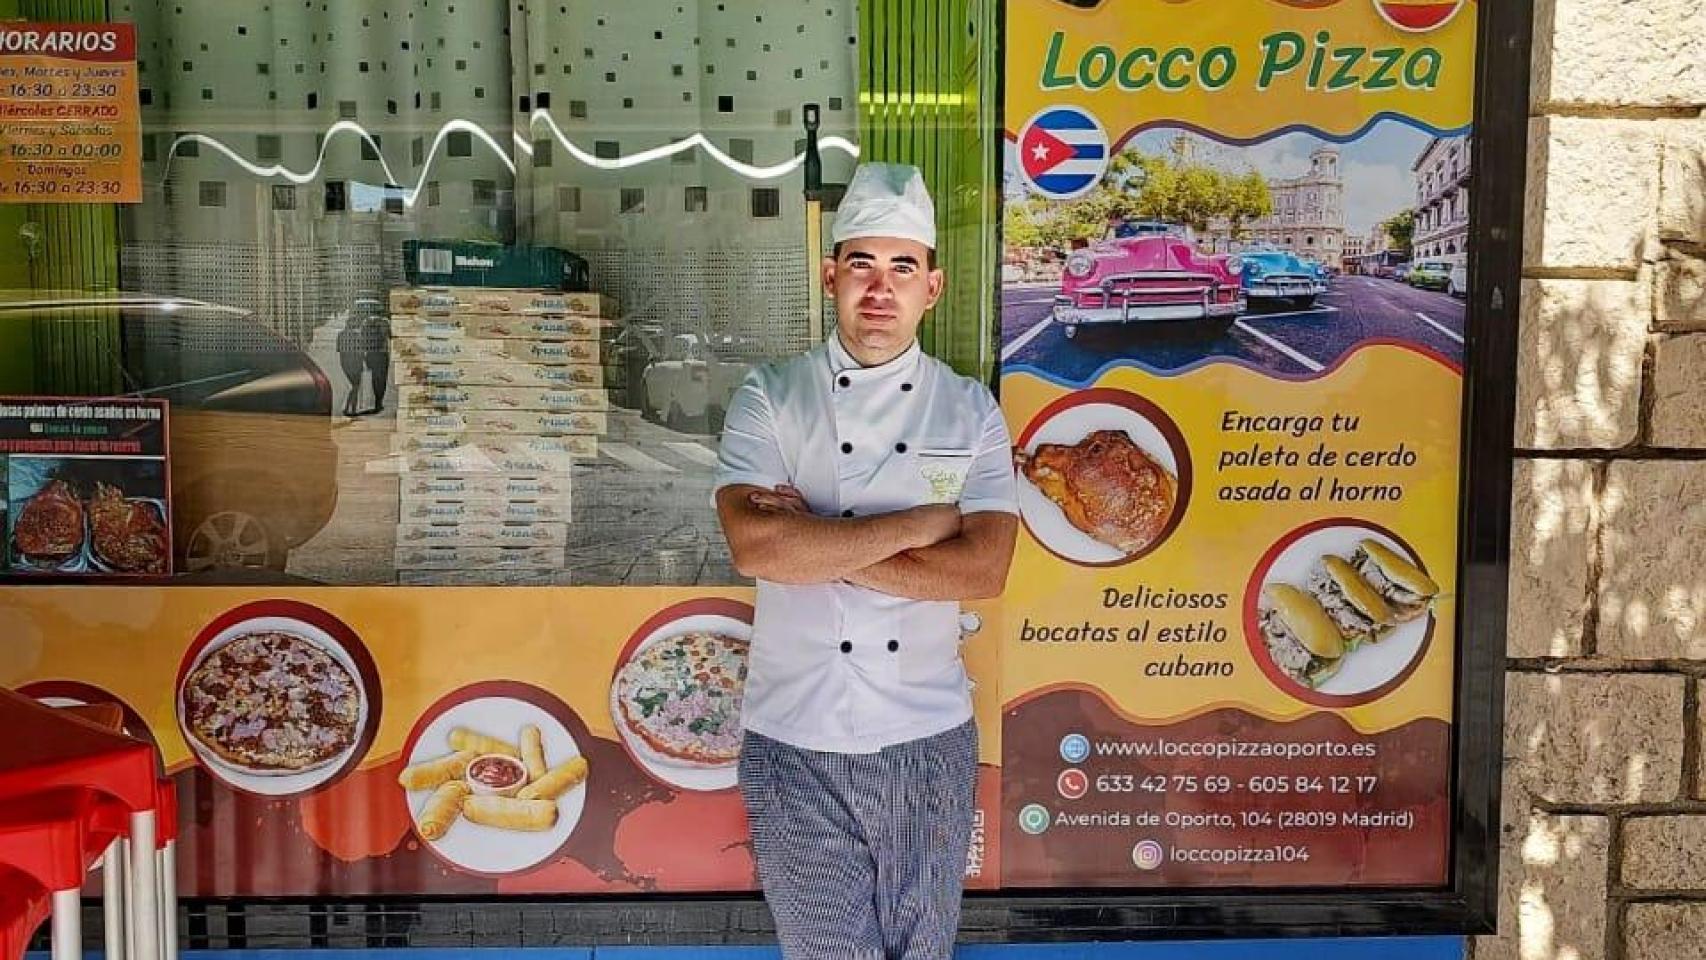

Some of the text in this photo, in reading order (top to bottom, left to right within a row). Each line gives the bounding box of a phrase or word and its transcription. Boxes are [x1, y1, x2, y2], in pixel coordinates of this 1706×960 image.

[1040, 30, 1443, 91] Locco Pizza
[10, 83, 52, 97] 16:30
[72, 83, 116, 97] 23:30
[56, 105, 118, 117] CERRADO
[10, 143, 52, 156] 16:30
[72, 143, 122, 156] 00:00
[15, 181, 56, 194] 16:30
[76, 181, 120, 194] 23:30
[1221, 410, 1359, 438] Encarga tu
[1219, 443, 1417, 471] paleta de cerdo
[1218, 477, 1402, 501] asada al horno
[1102, 587, 1228, 609] Deliciosos
[1020, 620, 1228, 643] bocatas al estilo
[1144, 654, 1235, 677] cubano
[1096, 739, 1377, 760] www.loccopizzaoporto.es
[1096, 776, 1134, 793] 633
[1141, 776, 1167, 793] 42
[1172, 776, 1198, 793] 75
[1204, 776, 1231, 793] 69
[1249, 776, 1290, 793] 605
[1295, 776, 1323, 793] 84
[1330, 776, 1350, 793] 12
[1357, 776, 1377, 793] 17
[1055, 811, 1414, 831] Avenida de Oporto, 104 (28019 Madrid)
[1170, 845, 1310, 866] loccopizza104
